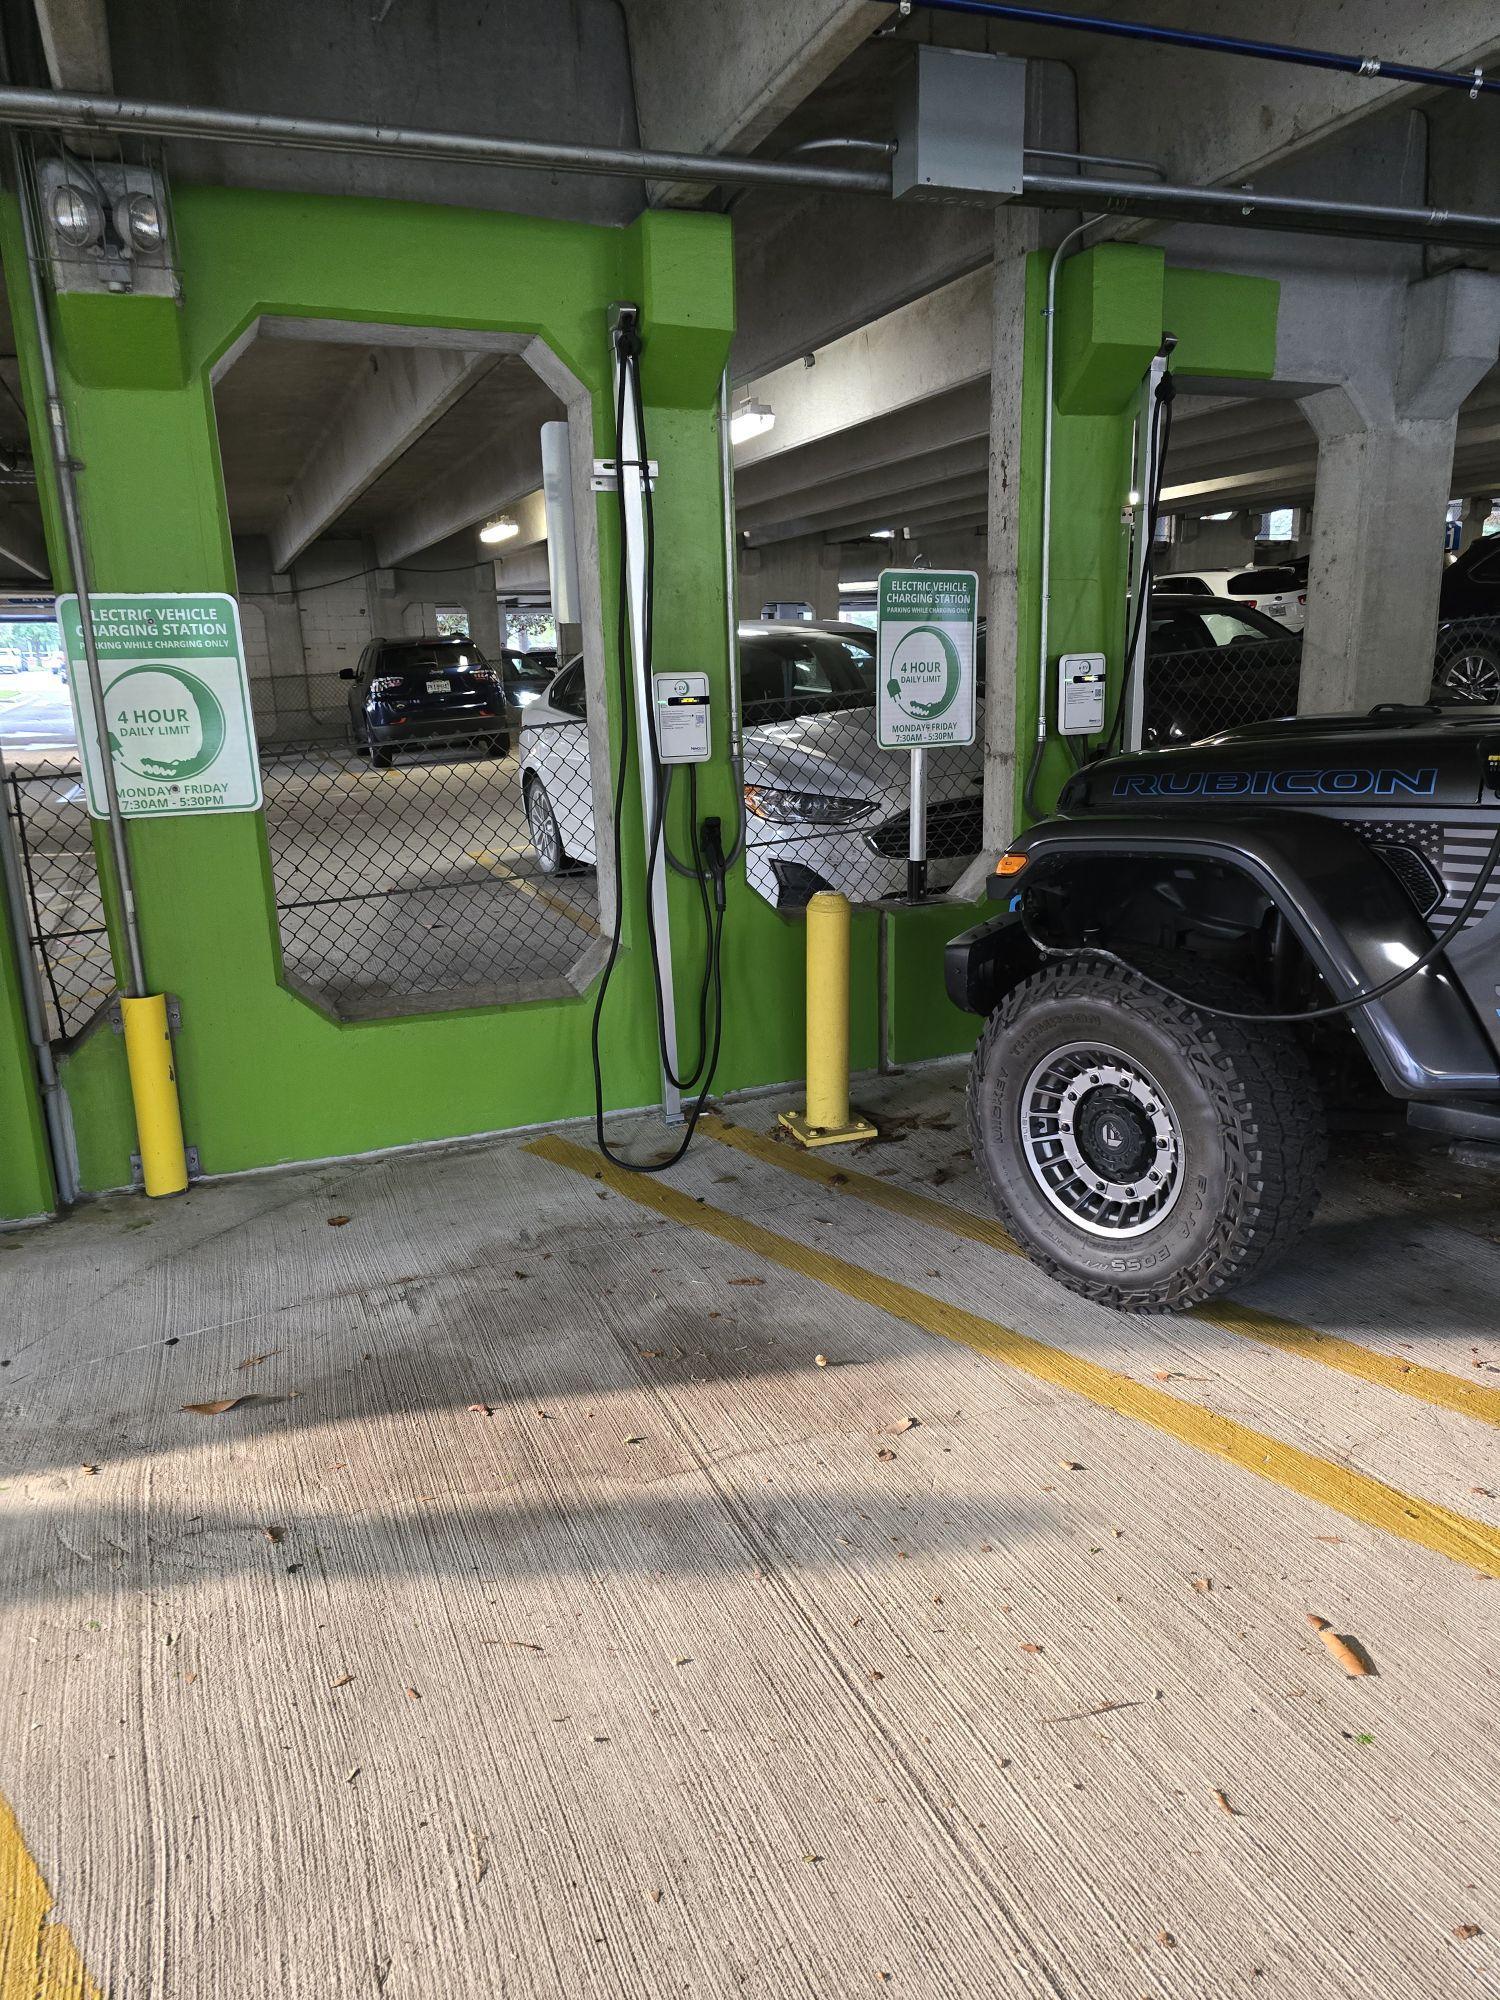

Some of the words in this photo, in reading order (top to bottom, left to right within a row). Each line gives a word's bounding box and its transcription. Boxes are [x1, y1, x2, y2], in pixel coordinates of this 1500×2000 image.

[891, 580, 932, 591] ELECTRIC
[933, 581, 967, 592] VEHICLE
[886, 593, 933, 603] CHARGING
[934, 593, 971, 604] STATION
[90, 608, 152, 622] LECTRIC
[154, 608, 218, 621] VEHICLE
[163, 623, 227, 636] STATION
[79, 641, 122, 650] PKING
[122, 641, 153, 649] WHILE
[154, 640, 203, 649] CHARGING
[204, 639, 229, 648] ONLY
[900, 662, 908, 673] 4
[910, 662, 941, 673] HOUR
[900, 675, 921, 684] DAILY
[922, 675, 941, 683] LIMIT
[117, 710, 128, 724] 4
[133, 709, 189, 724] HOUR
[120, 727, 155, 737] DAILY
[158, 725, 191, 736] LIMIT
[891, 723, 926, 733] MONDAY
[931, 722, 958, 731] FRIDAY
[895, 733, 923, 742] 7:30AM
[928, 731, 954, 741] 5:30PM
[1112, 768, 1438, 796] RUBICON
[116, 786, 172, 799] MONDAY
[184, 782, 229, 795] FRIDAY
[121, 798, 169, 811] 7:30AM
[179, 795, 224, 807] 5:30PM
